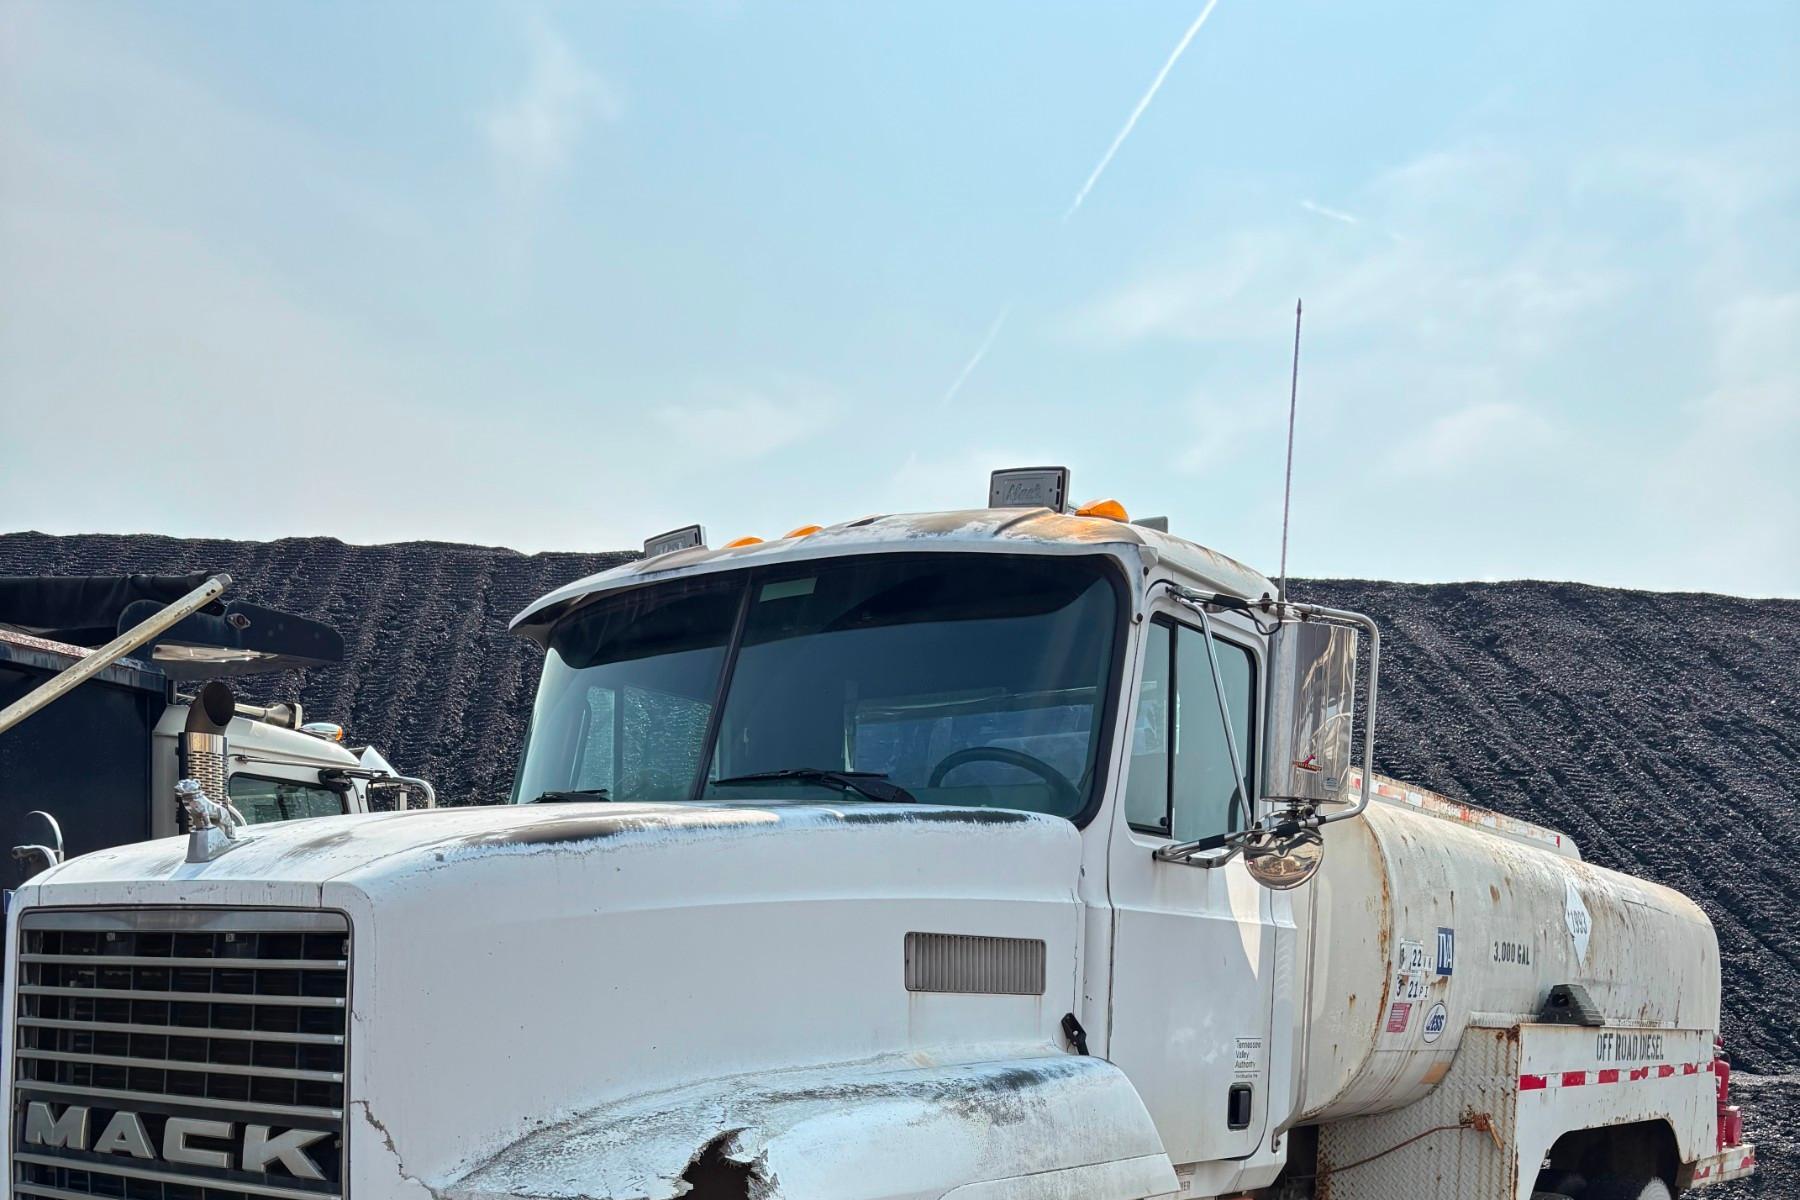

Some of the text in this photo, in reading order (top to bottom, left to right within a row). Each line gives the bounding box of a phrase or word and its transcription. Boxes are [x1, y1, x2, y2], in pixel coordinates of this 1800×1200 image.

[1494, 942, 1530, 965] 3,000 GAL
[1597, 1033, 1664, 1061] OFF ROAD DIESEL
[25, 1101, 334, 1181] MACK
